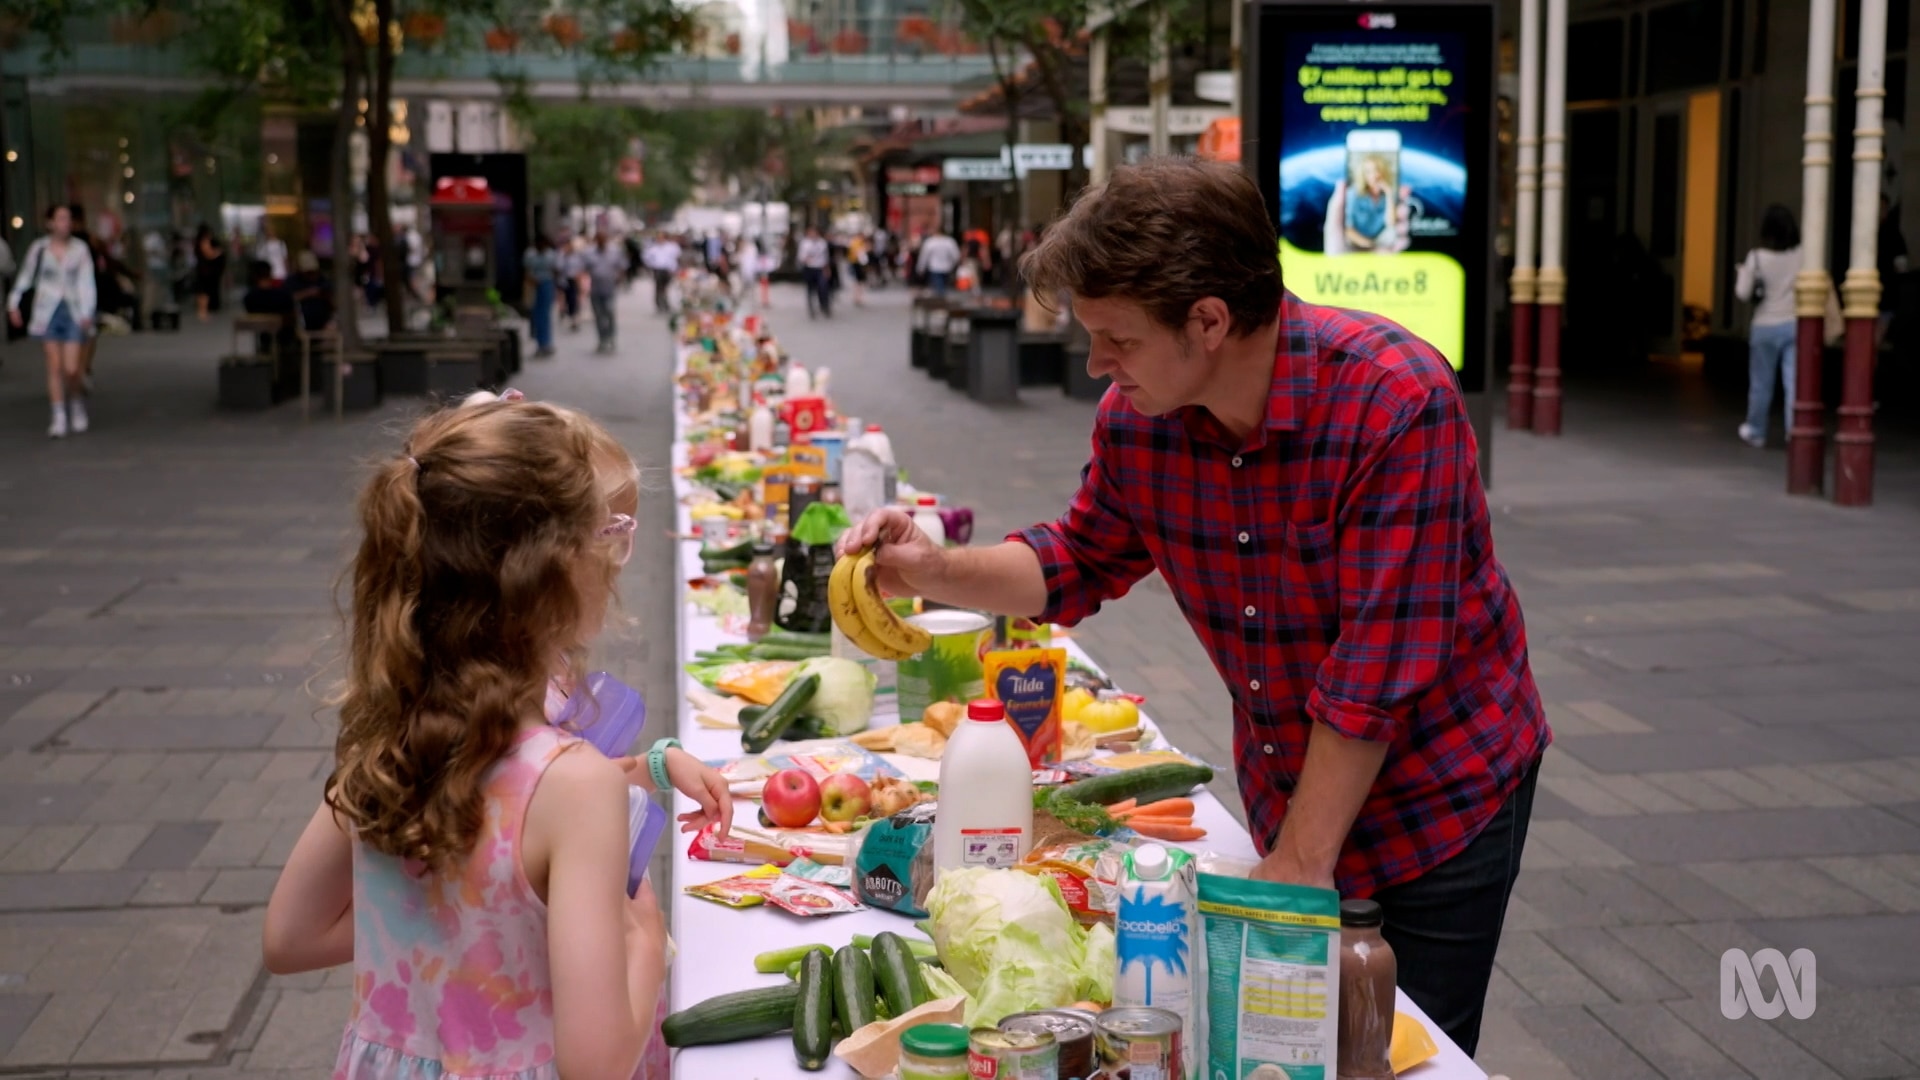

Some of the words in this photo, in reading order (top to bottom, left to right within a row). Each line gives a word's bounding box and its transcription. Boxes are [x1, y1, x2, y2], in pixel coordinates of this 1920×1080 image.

[1322, 66, 1376, 85] million
[1377, 66, 1406, 85] will
[1407, 69, 1431, 89] go
[1432, 67, 1453, 86] to
[1303, 85, 1364, 104] climate
[1320, 105, 1368, 124] every
[1315, 271, 1428, 295] WeAre8
[1007, 675, 1045, 694] Tilda
